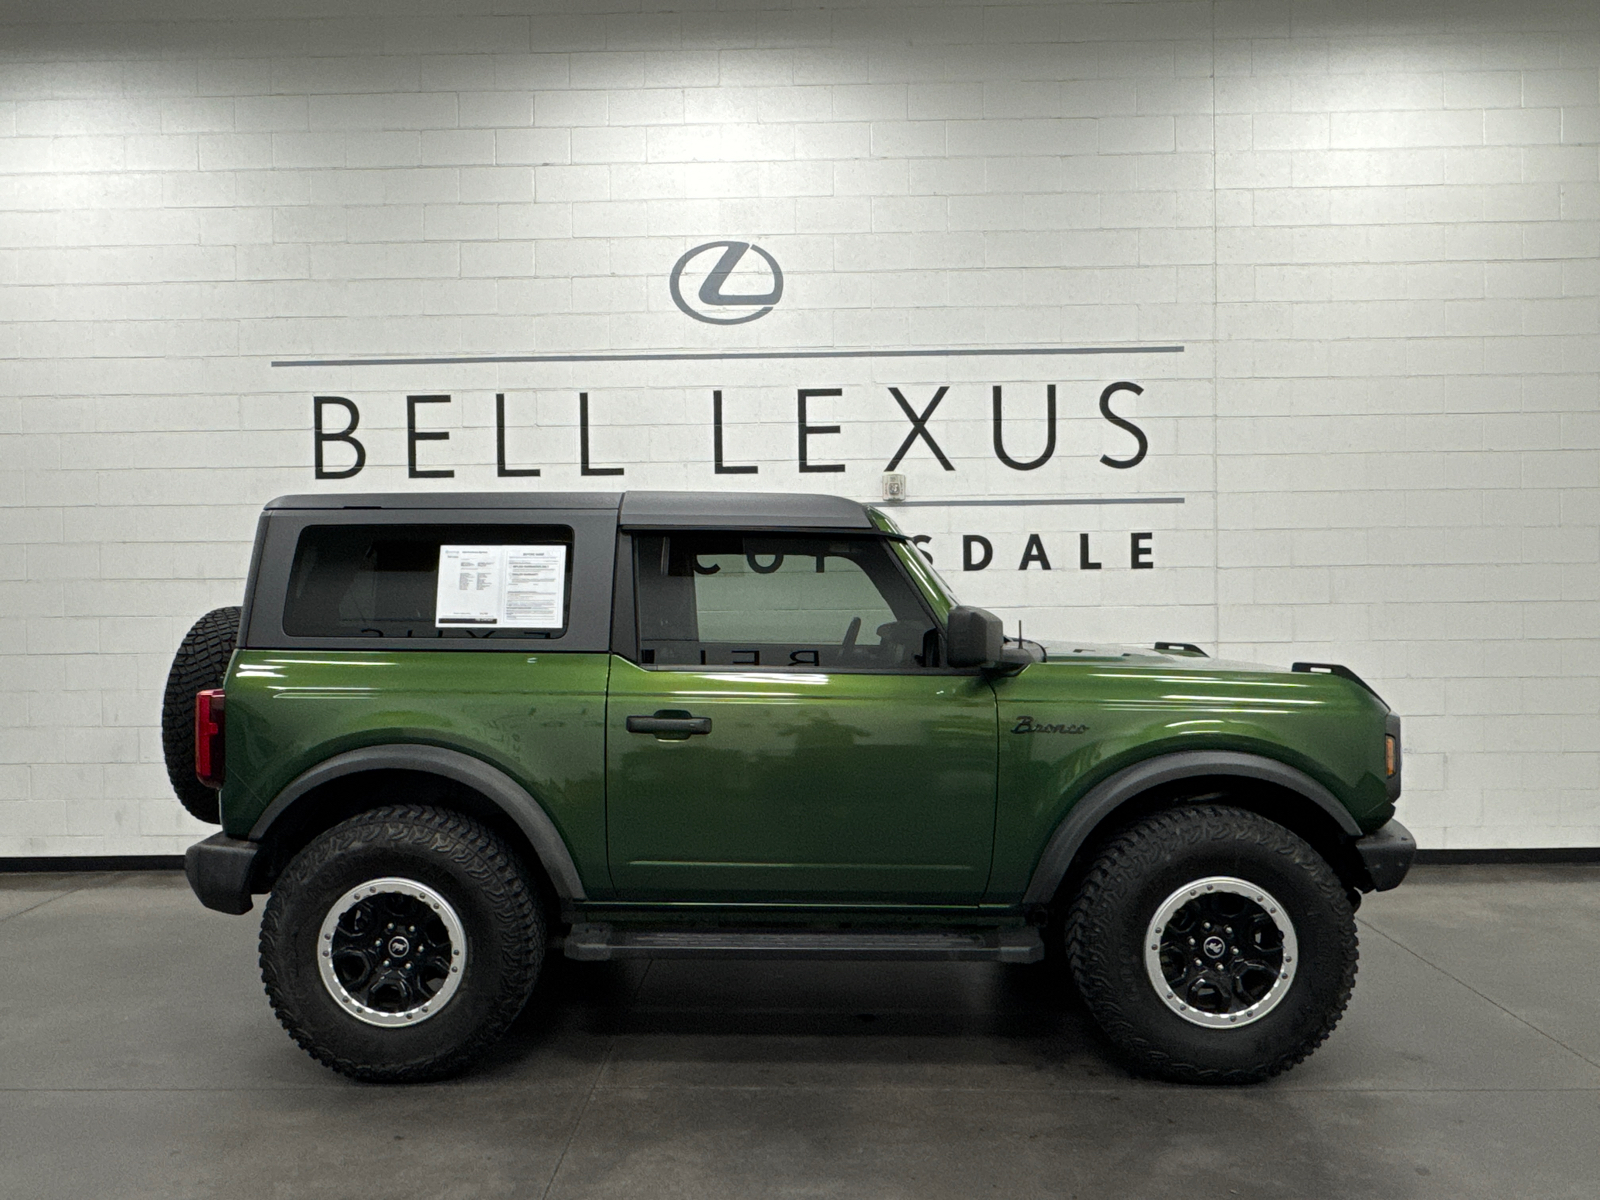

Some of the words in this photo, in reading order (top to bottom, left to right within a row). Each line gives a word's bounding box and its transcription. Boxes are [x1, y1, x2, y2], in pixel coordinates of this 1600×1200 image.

[314, 392, 624, 479] BELL
[714, 382, 1148, 474] LEXUS
[1010, 715, 1087, 734] Bronco
